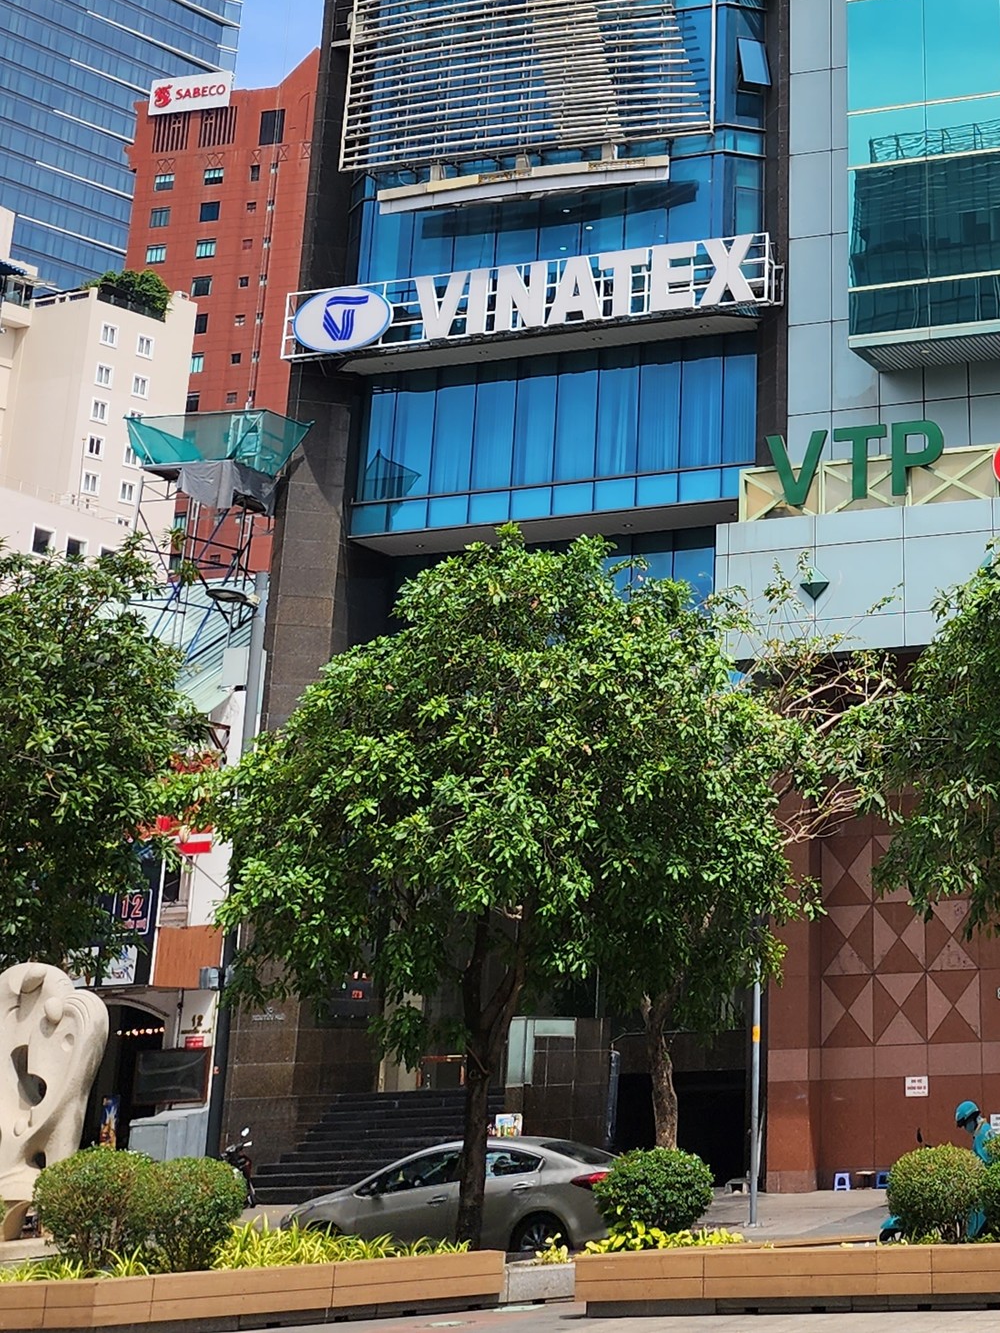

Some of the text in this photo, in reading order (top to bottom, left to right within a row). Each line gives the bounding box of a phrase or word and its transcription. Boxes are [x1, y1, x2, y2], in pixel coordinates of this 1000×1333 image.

[175, 84, 226, 100] SABECO
[415, 233, 756, 340] VINATEX
[765, 419, 944, 506] VTP
[121, 894, 144, 918] 12
[191, 1014, 204, 1027] 12
